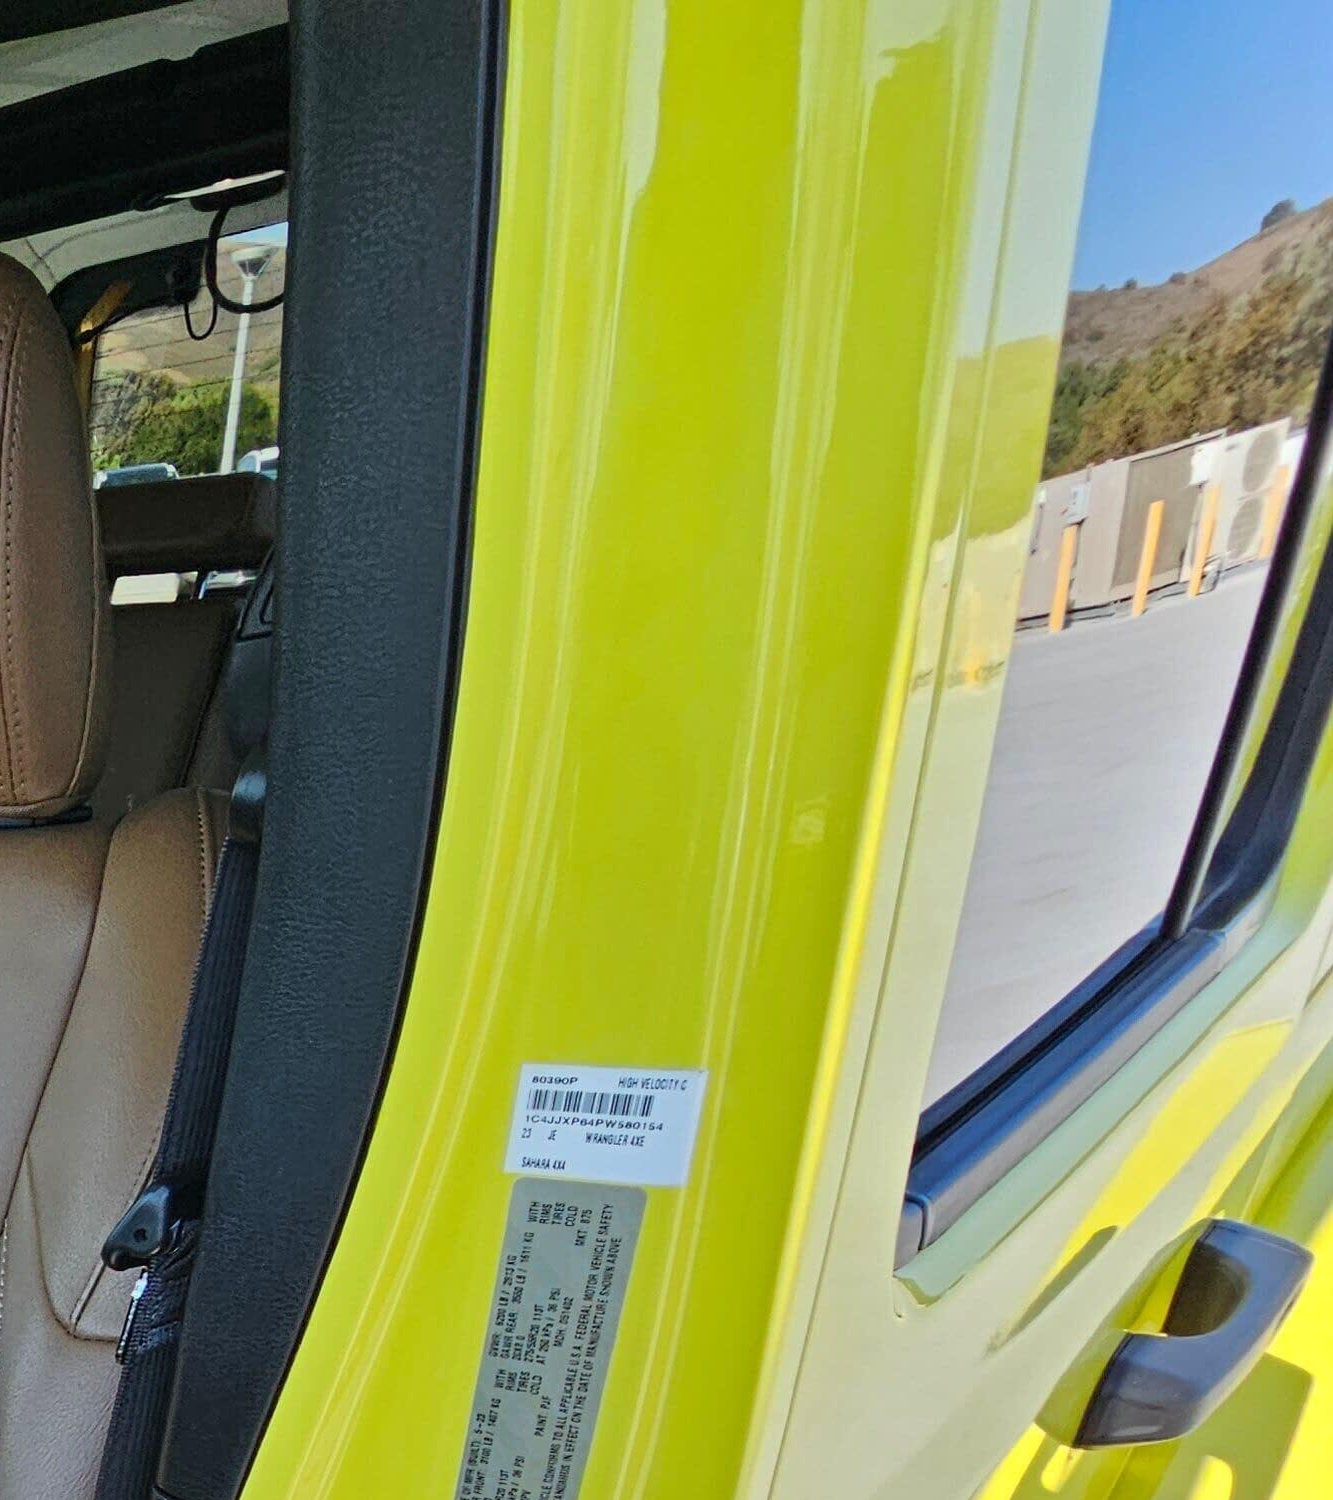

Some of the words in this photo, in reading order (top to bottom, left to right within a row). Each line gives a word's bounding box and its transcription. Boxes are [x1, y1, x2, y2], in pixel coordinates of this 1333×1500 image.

[618, 1077, 638, 1088] HIGH
[640, 1078, 680, 1090] VELOCITY
[521, 1128, 532, 1139] 23
[585, 1132, 629, 1146] WRANGLER
[526, 1200, 540, 1222] WITH
[538, 1202, 552, 1224] RIMS
[551, 1201, 565, 1225] TIRES
[563, 1204, 578, 1227] COLD
[596, 1202, 614, 1235] SAFETY
[588, 1237, 606, 1271] VEHICLE
[582, 1272, 598, 1302] MOTOR
[598, 1264, 616, 1296] SHOWN
[573, 1303, 592, 1341] FEDERAL
[584, 1298, 608, 1358] MANUFACTURE
[581, 1358, 595, 1370] OF
[493, 1368, 506, 1388] WITH
[505, 1370, 518, 1391] RIMS
[517, 1370, 530, 1392] TIRES
[528, 1374, 542, 1395] COLD
[576, 1370, 592, 1393] DATE
[557, 1367, 578, 1414] APPLICABLE
[573, 1394, 587, 1410] THE
[554, 1414, 567, 1429] ALL
[570, 1410, 583, 1423] ON
[551, 1430, 563, 1442] TO
[563, 1424, 580, 1453] EFFECT
